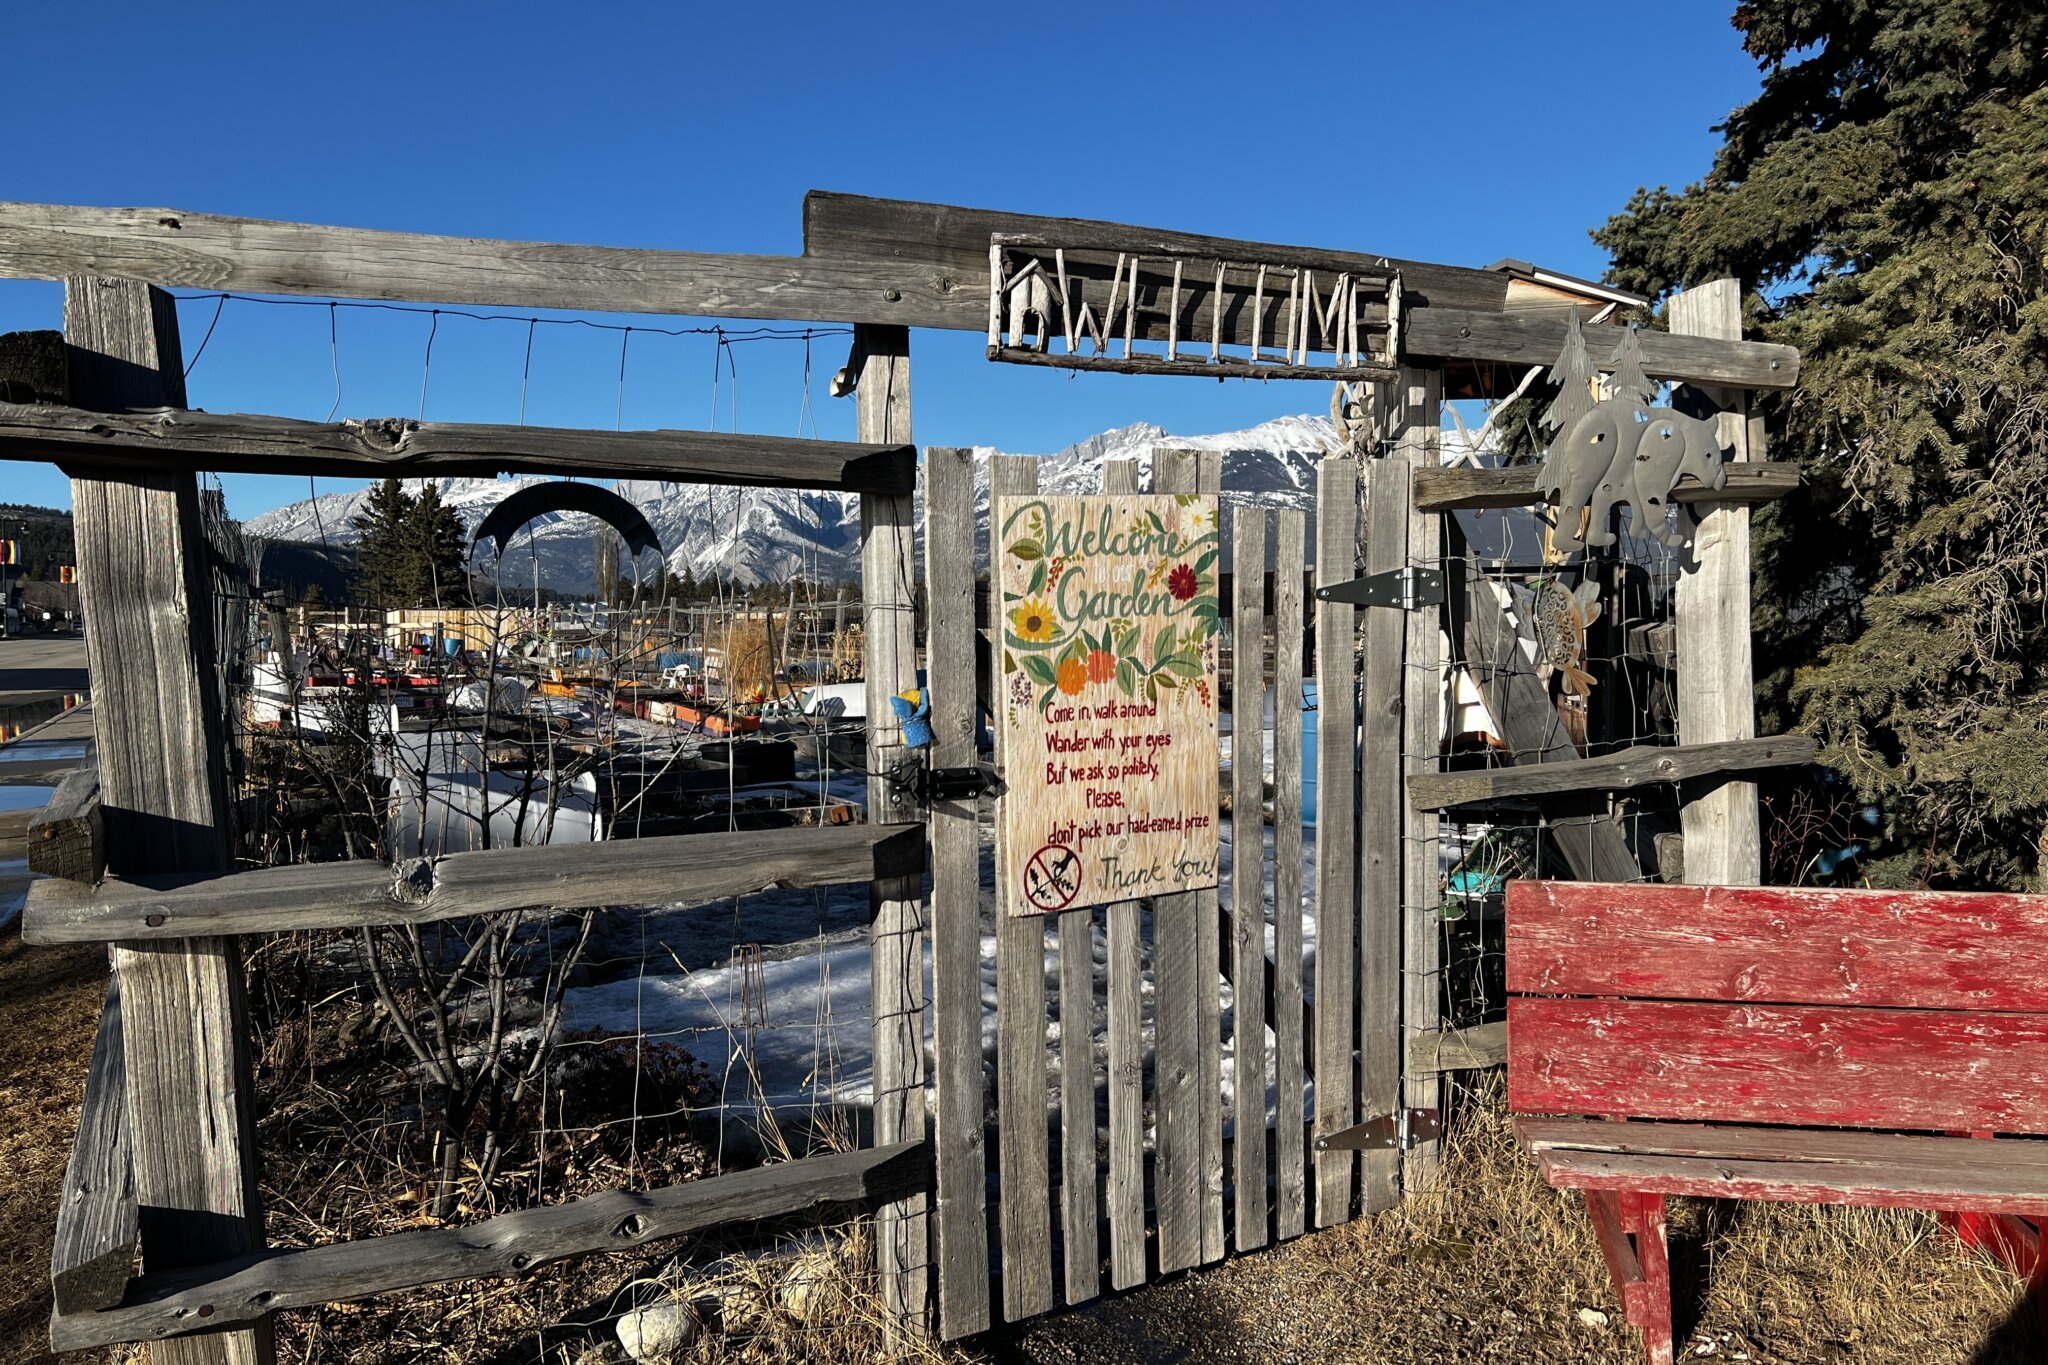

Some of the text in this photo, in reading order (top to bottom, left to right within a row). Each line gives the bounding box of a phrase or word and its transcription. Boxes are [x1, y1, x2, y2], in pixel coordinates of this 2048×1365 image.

[1002, 501, 1218, 558] Welcome
[1048, 567, 1217, 641] Garden
[1045, 701, 1075, 724] Come
[1093, 700, 1118, 719] walk
[1120, 698, 1158, 718] around
[1045, 728, 1171, 757] Wander with your eyes
[1046, 756, 1159, 785] But we ask so politely.
[1078, 819, 1102, 852] pick
[1106, 821, 1125, 836] our
[1128, 811, 1181, 834] hard-earned
[1185, 811, 1209, 839] prize
[1101, 847, 1219, 890] Thank You!
